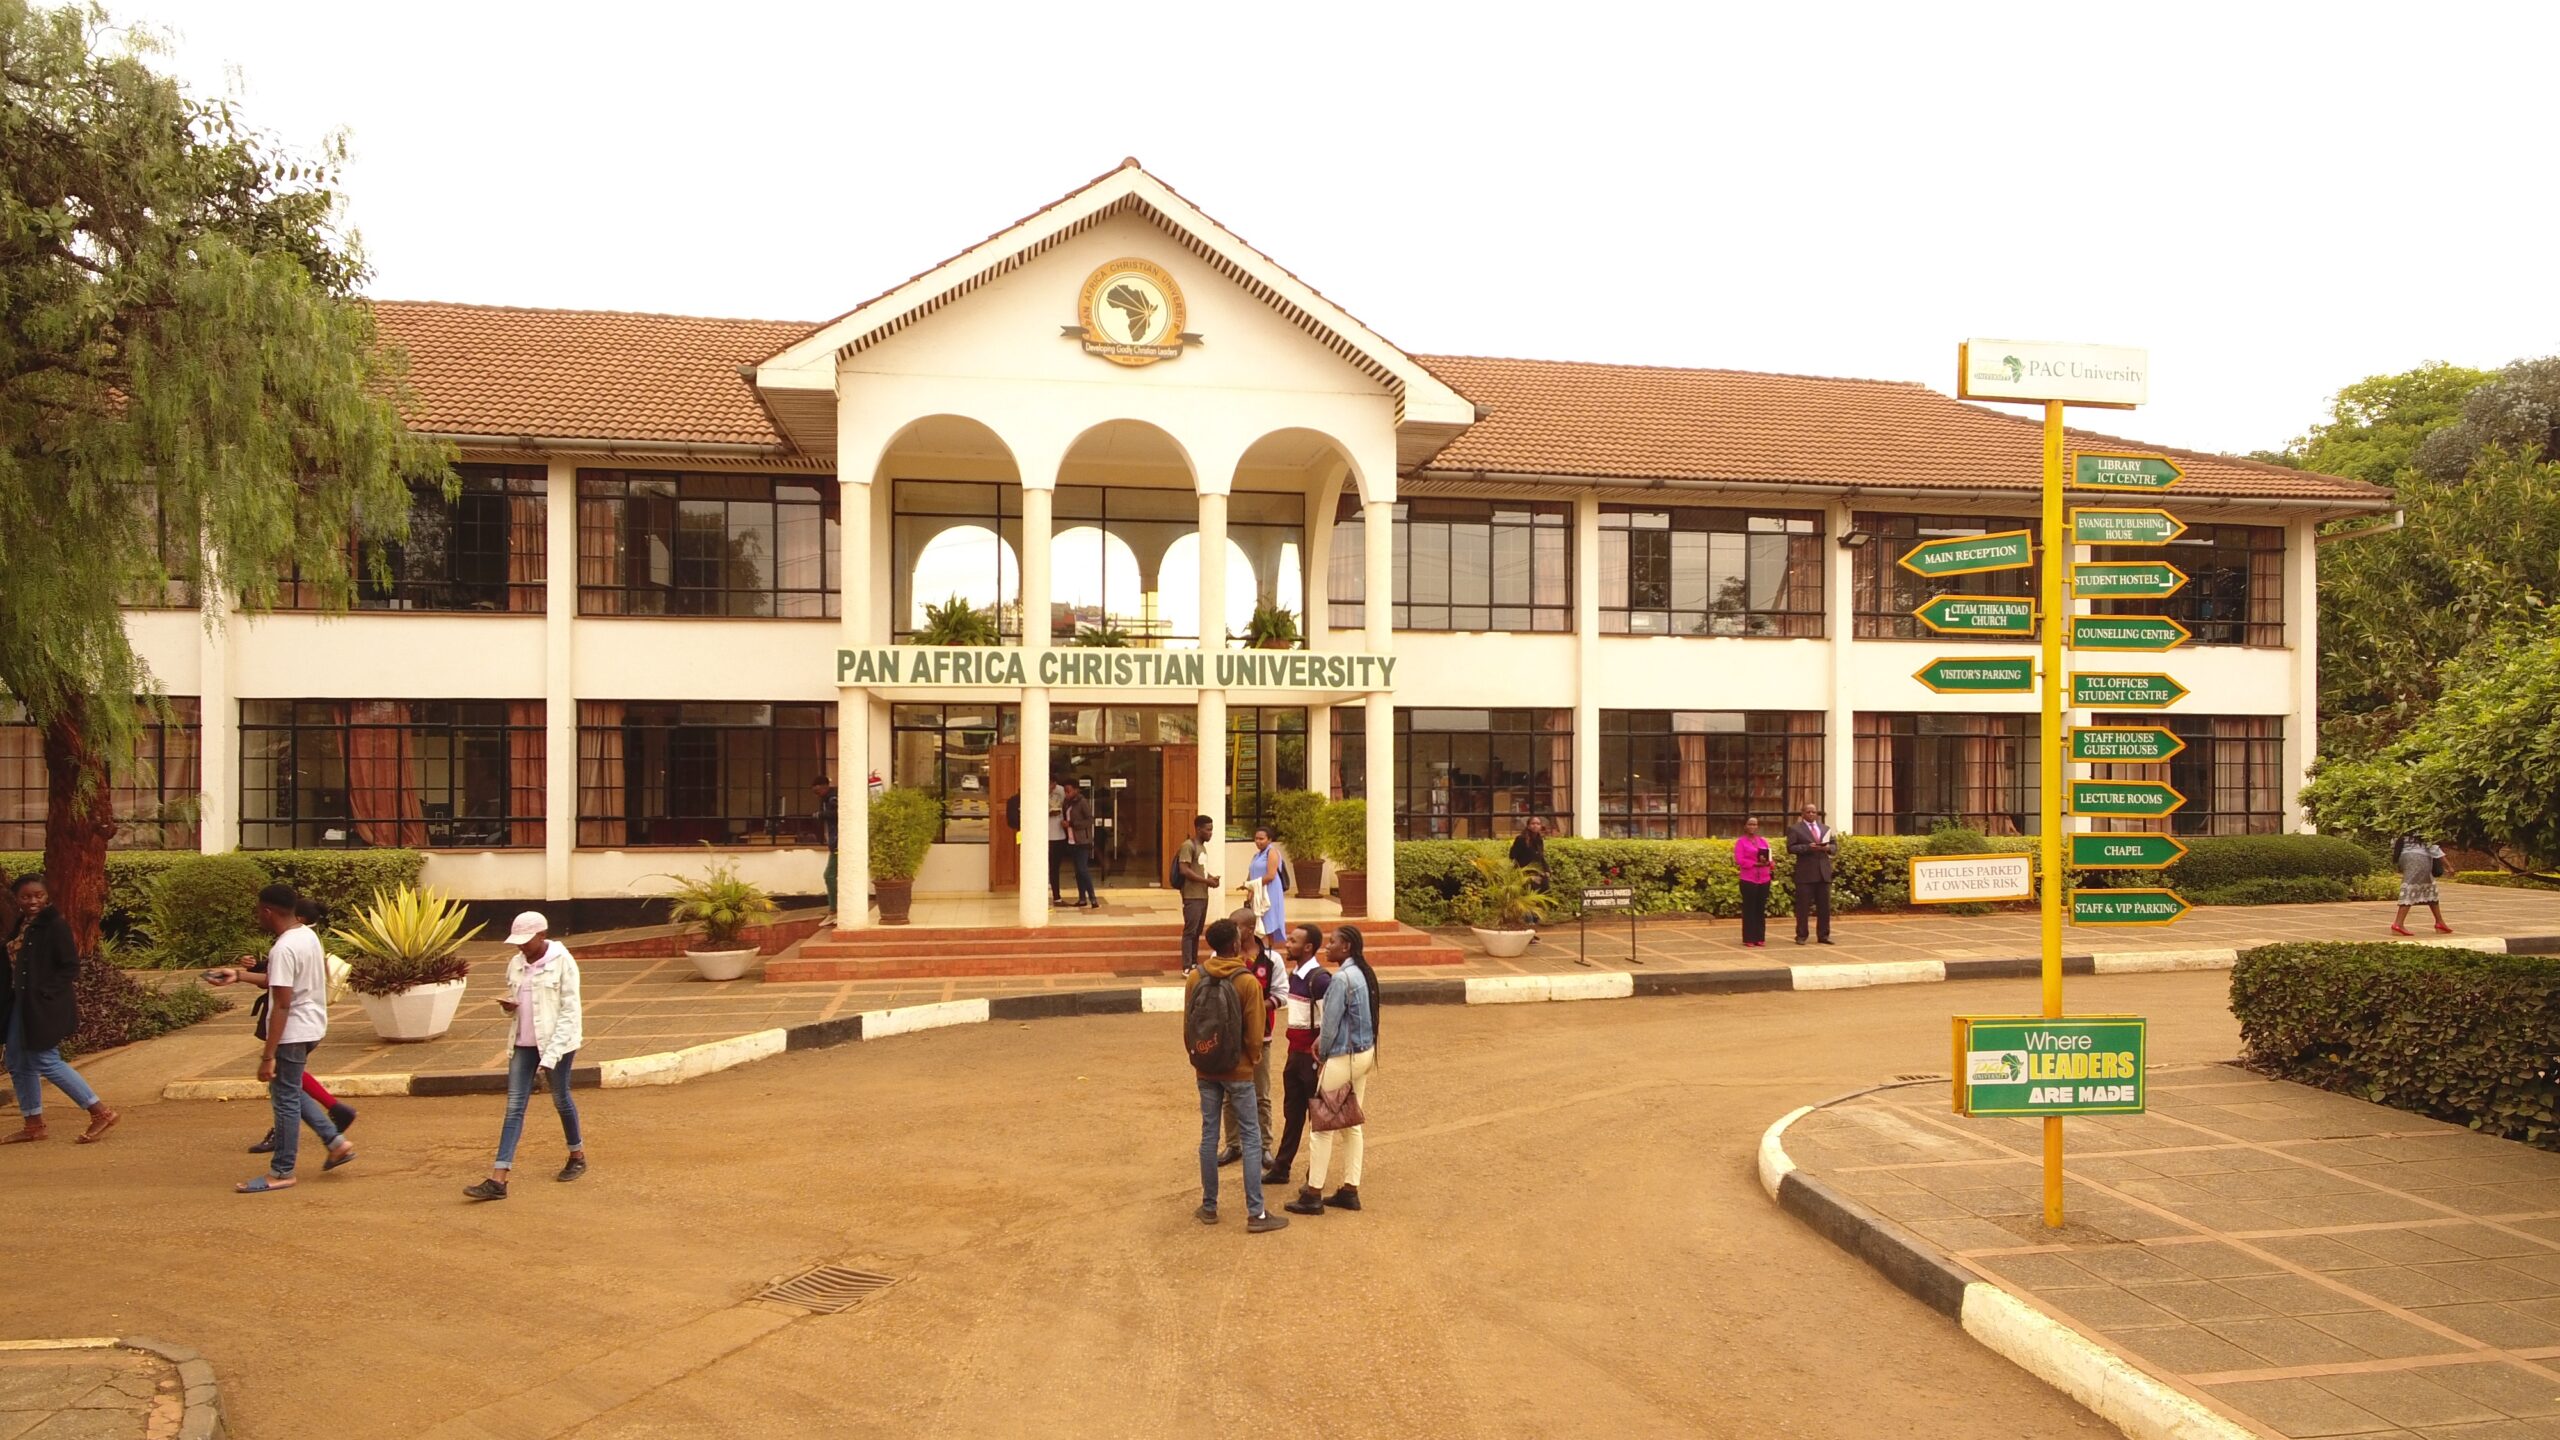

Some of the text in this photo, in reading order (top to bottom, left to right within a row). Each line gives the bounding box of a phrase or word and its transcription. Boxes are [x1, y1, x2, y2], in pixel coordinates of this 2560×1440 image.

[1085, 271, 1107, 301] AFRICA
[1109, 261, 1160, 276] CHRISTIAN
[1162, 275, 1184, 331] UNIVERSITY
[2029, 360, 2065, 378] PAC
[2070, 361, 2143, 383] University
[2098, 459, 2142, 472] LIBRARY
[2097, 472, 2158, 486] ICT CENTRE
[2078, 518, 2164, 530] EVANGEL PUBLISHING
[2105, 529, 2134, 540] HOUSE
[1925, 544, 2018, 565] MAIN RECEPTION
[2074, 574, 2160, 586] STUDENT HOSTELS
[1951, 604, 2029, 616] CITAM THIKA ROAD
[1971, 615, 2007, 627] CHURCH
[2077, 627, 2176, 640] COUNSELLING CENTRE
[836, 649, 1397, 688] PAN AFRICA CHRISTIAN UNIVERSITY
[1940, 669, 2022, 681] VISITOR'S PARKING
[2087, 677, 2149, 689] TCL OFFICES
[2078, 690, 2169, 701] STUDENT CENTRE
[2084, 732, 2155, 744] STAFF HOUSES
[2084, 744, 2159, 755] GUEST HOUSES
[2080, 793, 2163, 805] LECTURE ROOMS
[2104, 845, 2144, 857] CHAPEL
[1920, 864, 2023, 878] VEHICLES PARKED
[1924, 877, 2020, 891] AT OWNER'S RISK
[1584, 889, 1613, 897] VEHICLES
[2075, 902, 2177, 914] STAFF & VIP PARKING
[2024, 1031, 2093, 1051] Where
[2028, 1051, 2135, 1080] LEADERS
[2028, 1085, 2135, 1104] ARE MADE
